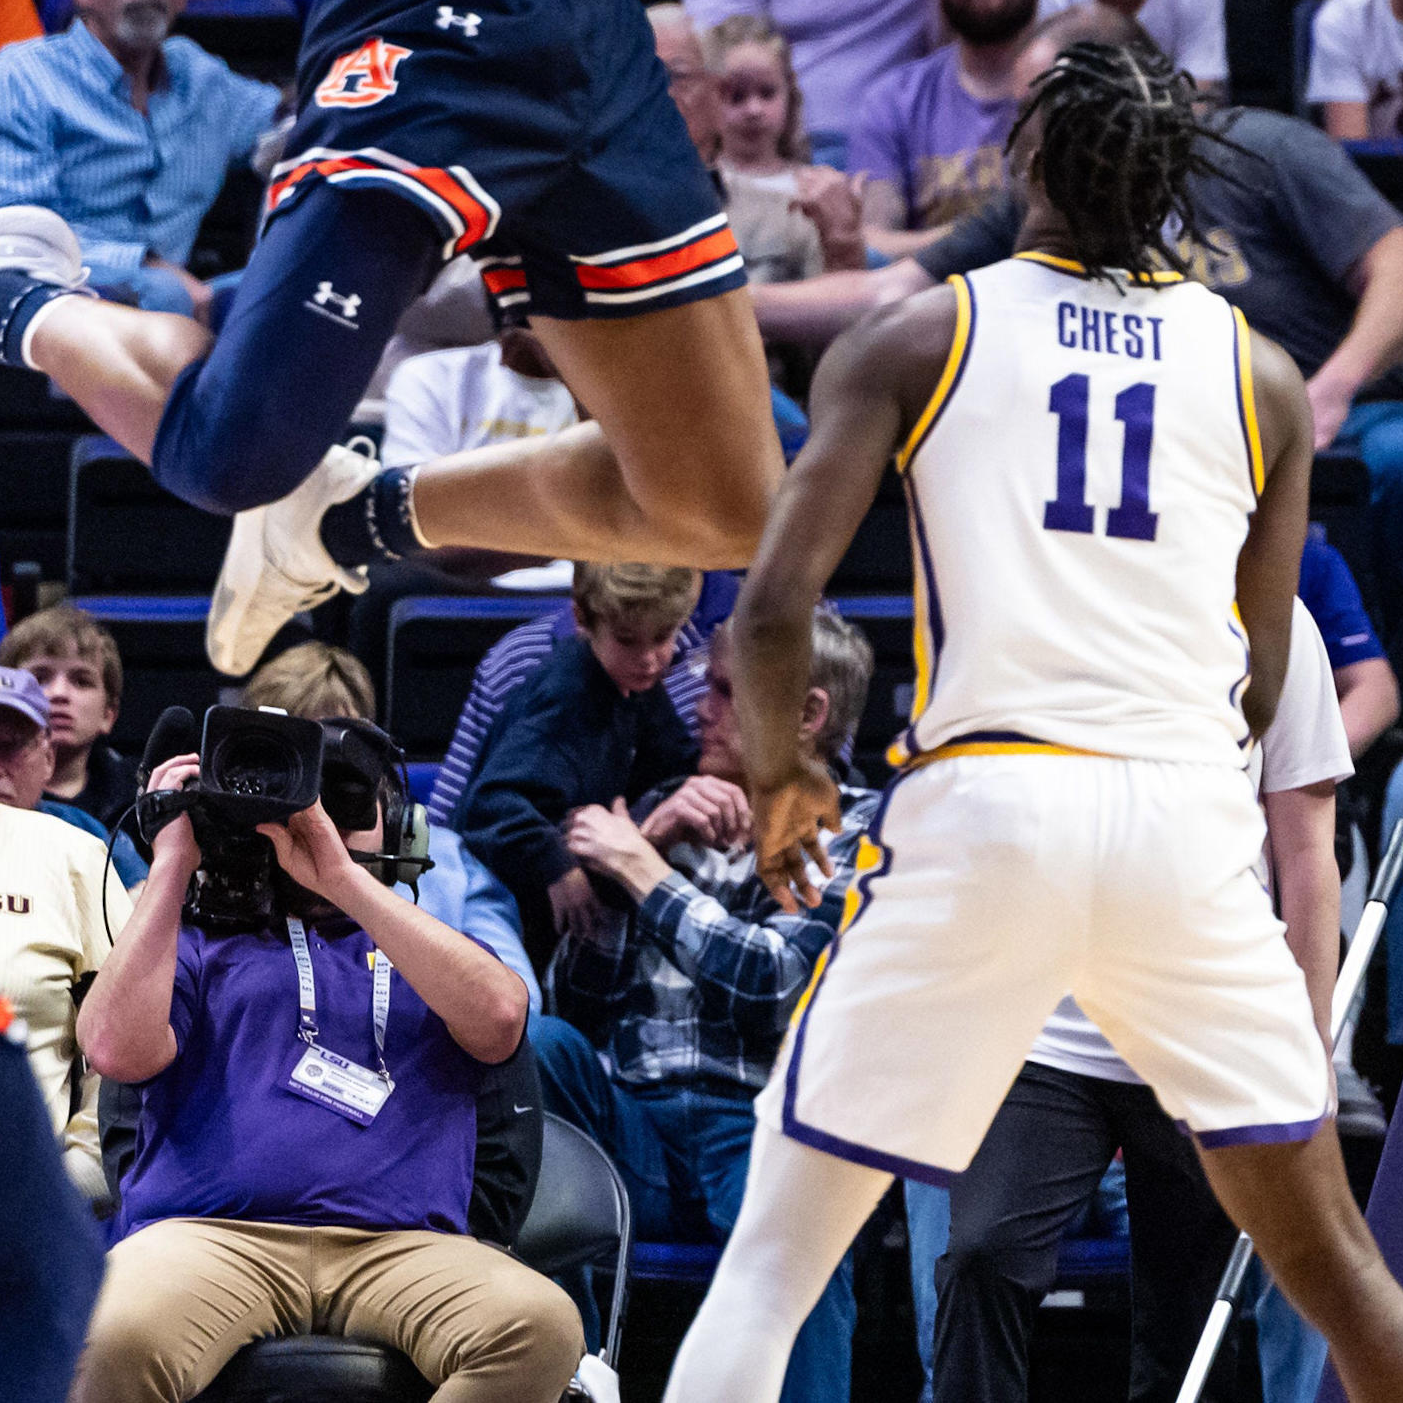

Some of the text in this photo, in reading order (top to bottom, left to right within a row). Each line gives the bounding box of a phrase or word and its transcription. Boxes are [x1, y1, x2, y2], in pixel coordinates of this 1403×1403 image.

[1057, 301, 1164, 361] CHEST
[1043, 372, 1160, 542] 11
[320, 1050, 350, 1070] LSU
